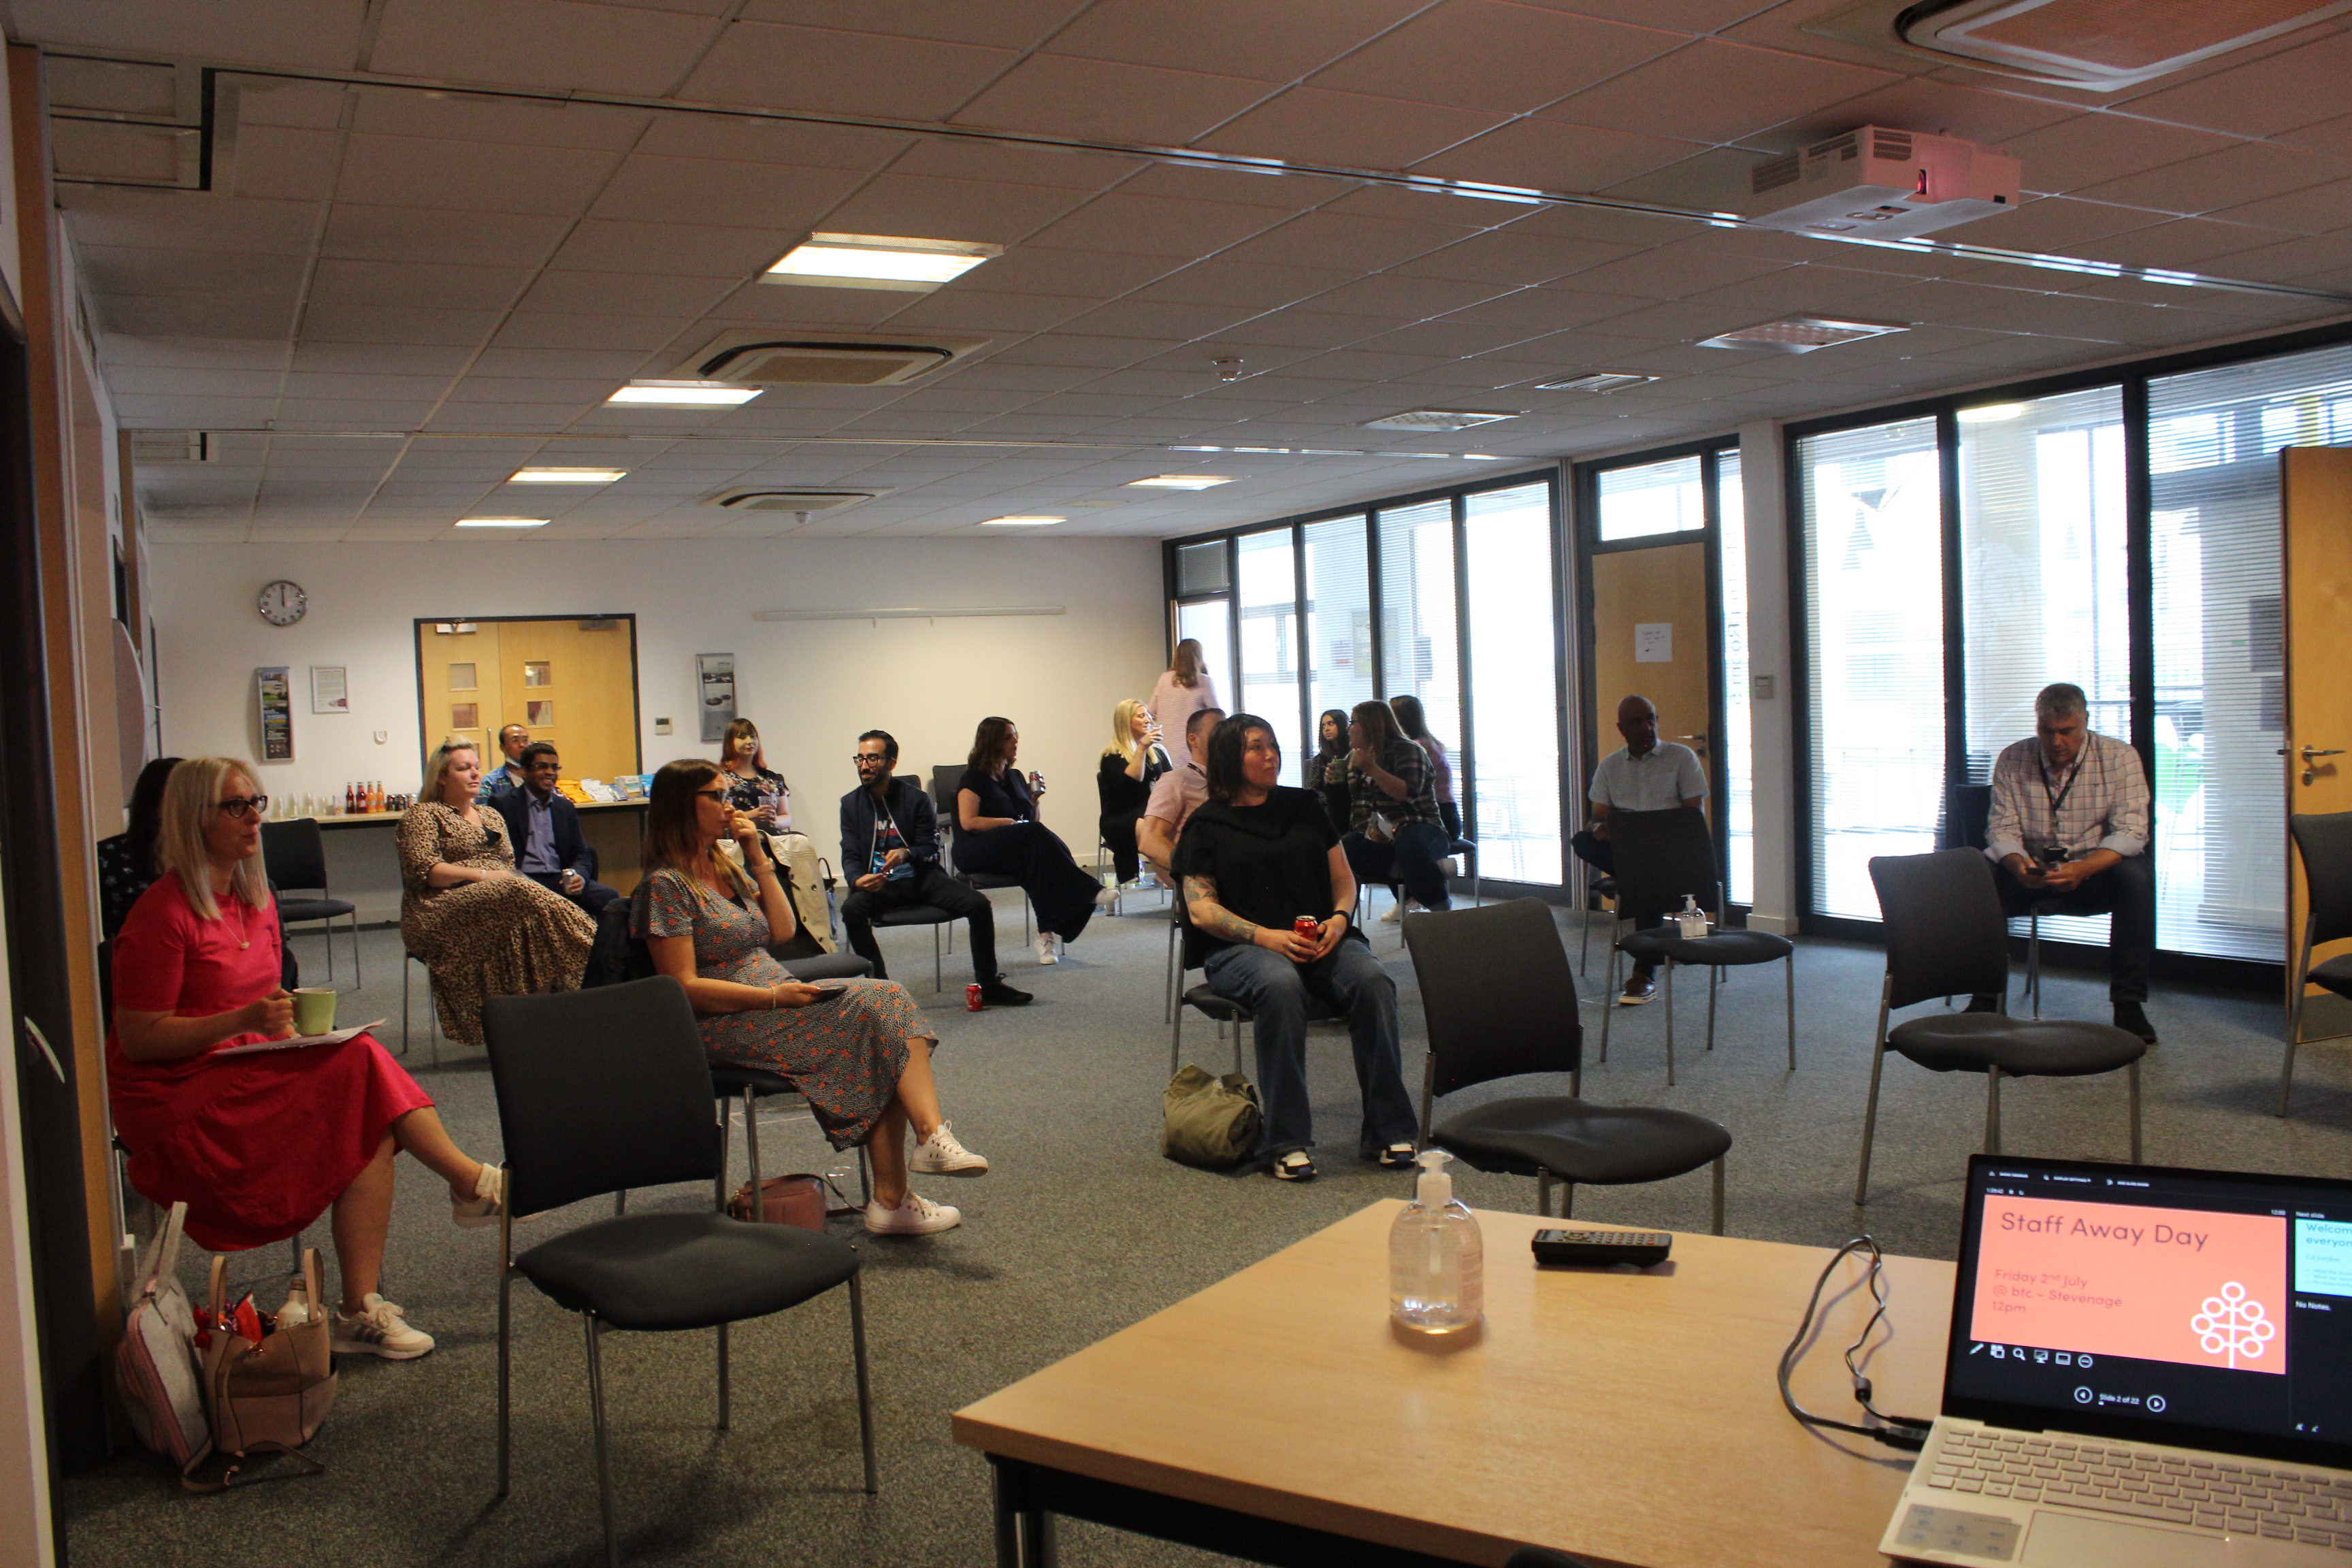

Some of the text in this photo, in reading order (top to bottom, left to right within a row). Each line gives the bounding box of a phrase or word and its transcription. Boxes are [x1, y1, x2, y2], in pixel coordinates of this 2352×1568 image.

[2001, 1212, 2208, 1252] Staff Away Day
[1995, 1270, 2036, 1285] Friday
[2062, 1276, 2088, 1290] July
[1993, 1286, 2007, 1297] @
[2012, 1287, 2033, 1298] btc
[2049, 1290, 2123, 1308] Stevenage
[1993, 1301, 2026, 1313] 12pm
